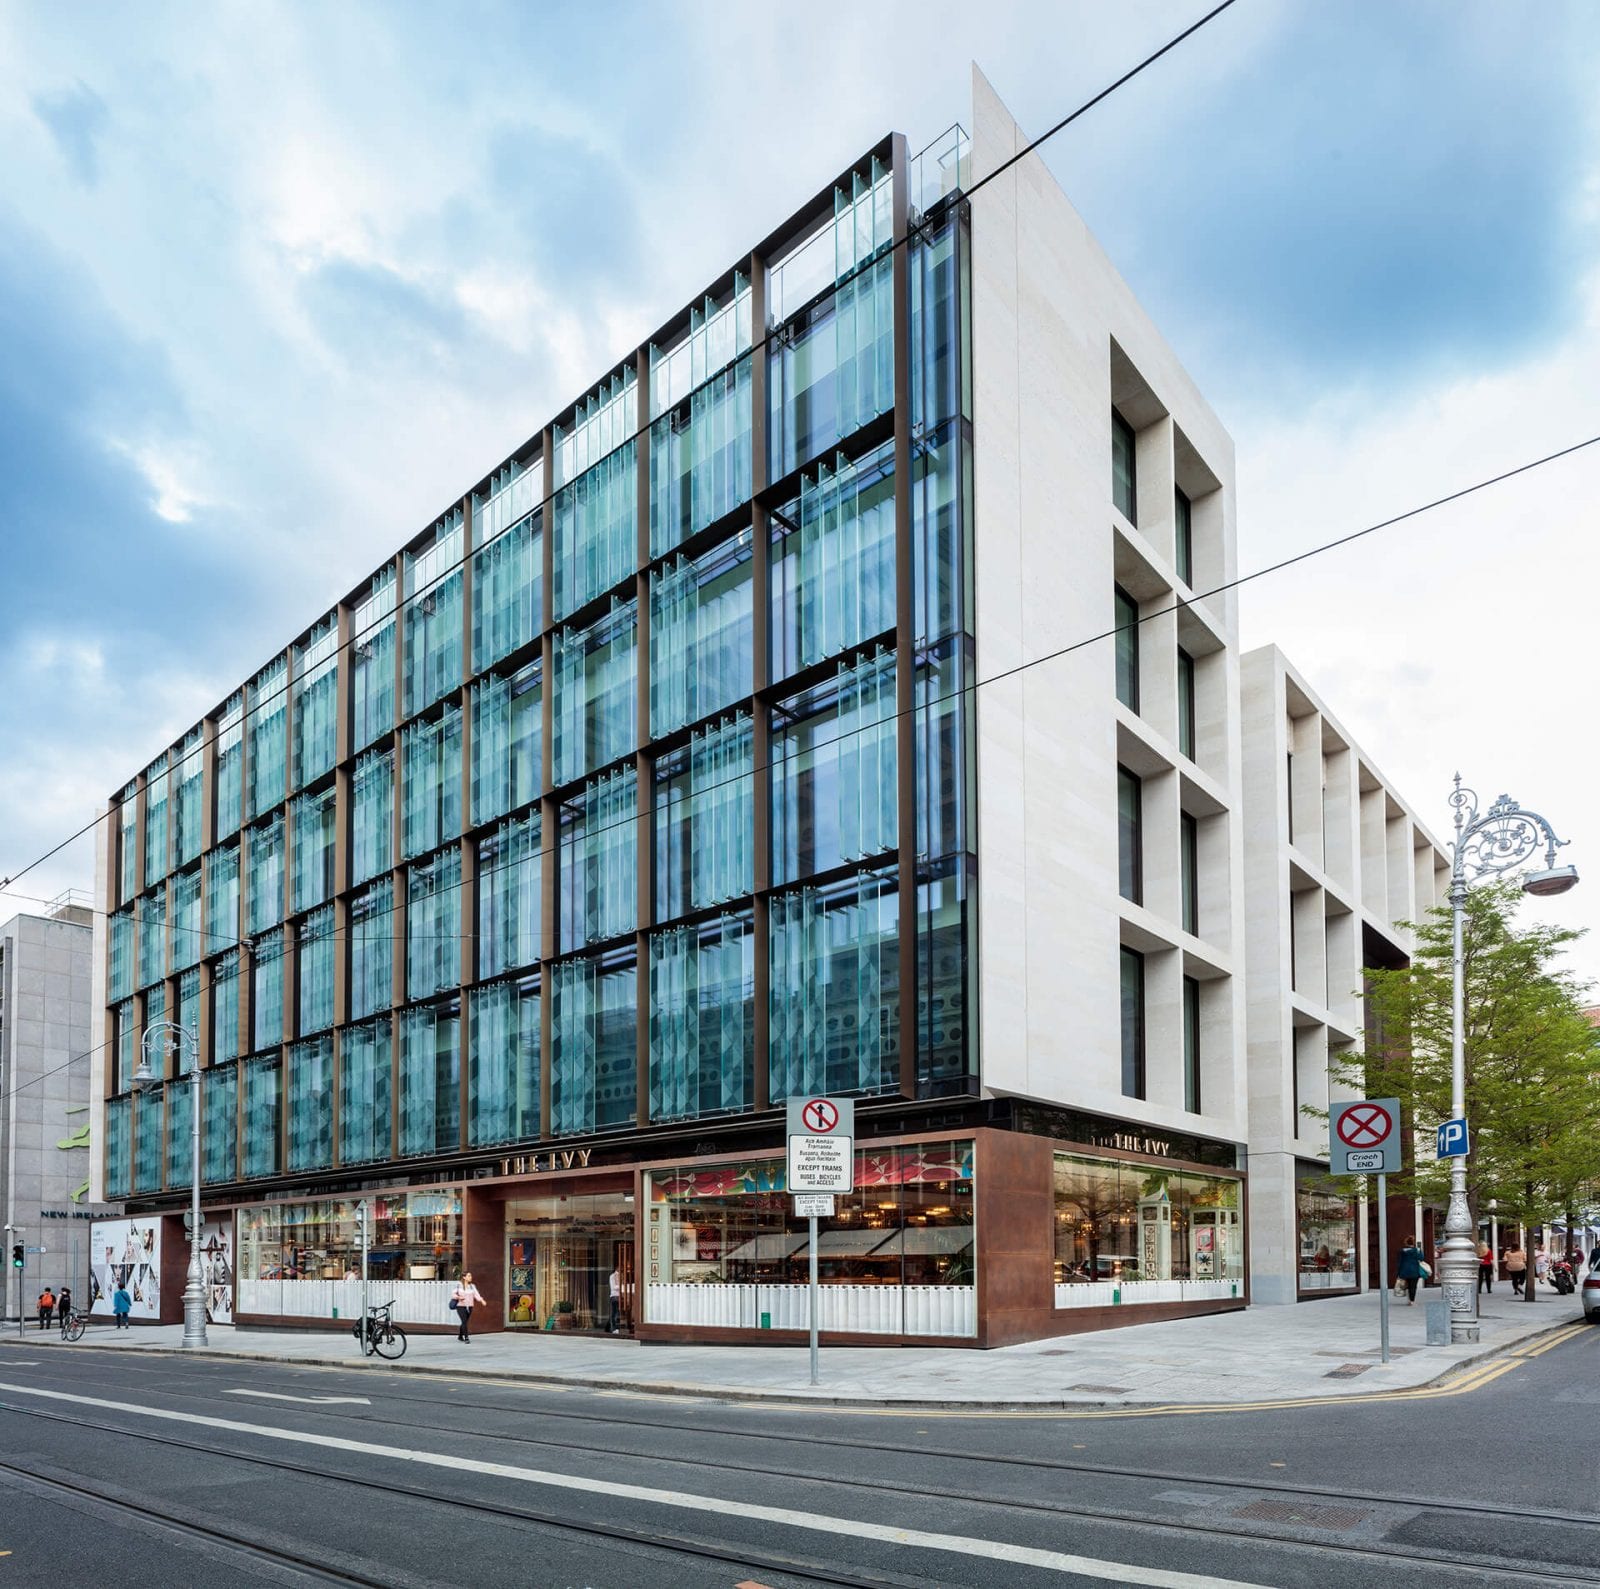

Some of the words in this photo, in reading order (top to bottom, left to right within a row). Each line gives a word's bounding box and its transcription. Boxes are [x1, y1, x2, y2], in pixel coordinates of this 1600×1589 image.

[1114, 1133, 1141, 1151] THE
[1145, 1139, 1169, 1156] IVY
[1445, 1124, 1463, 1152] P
[500, 1155, 539, 1175] THE
[549, 1148, 592, 1170] IVY
[40, 1211, 68, 1219] NEW
